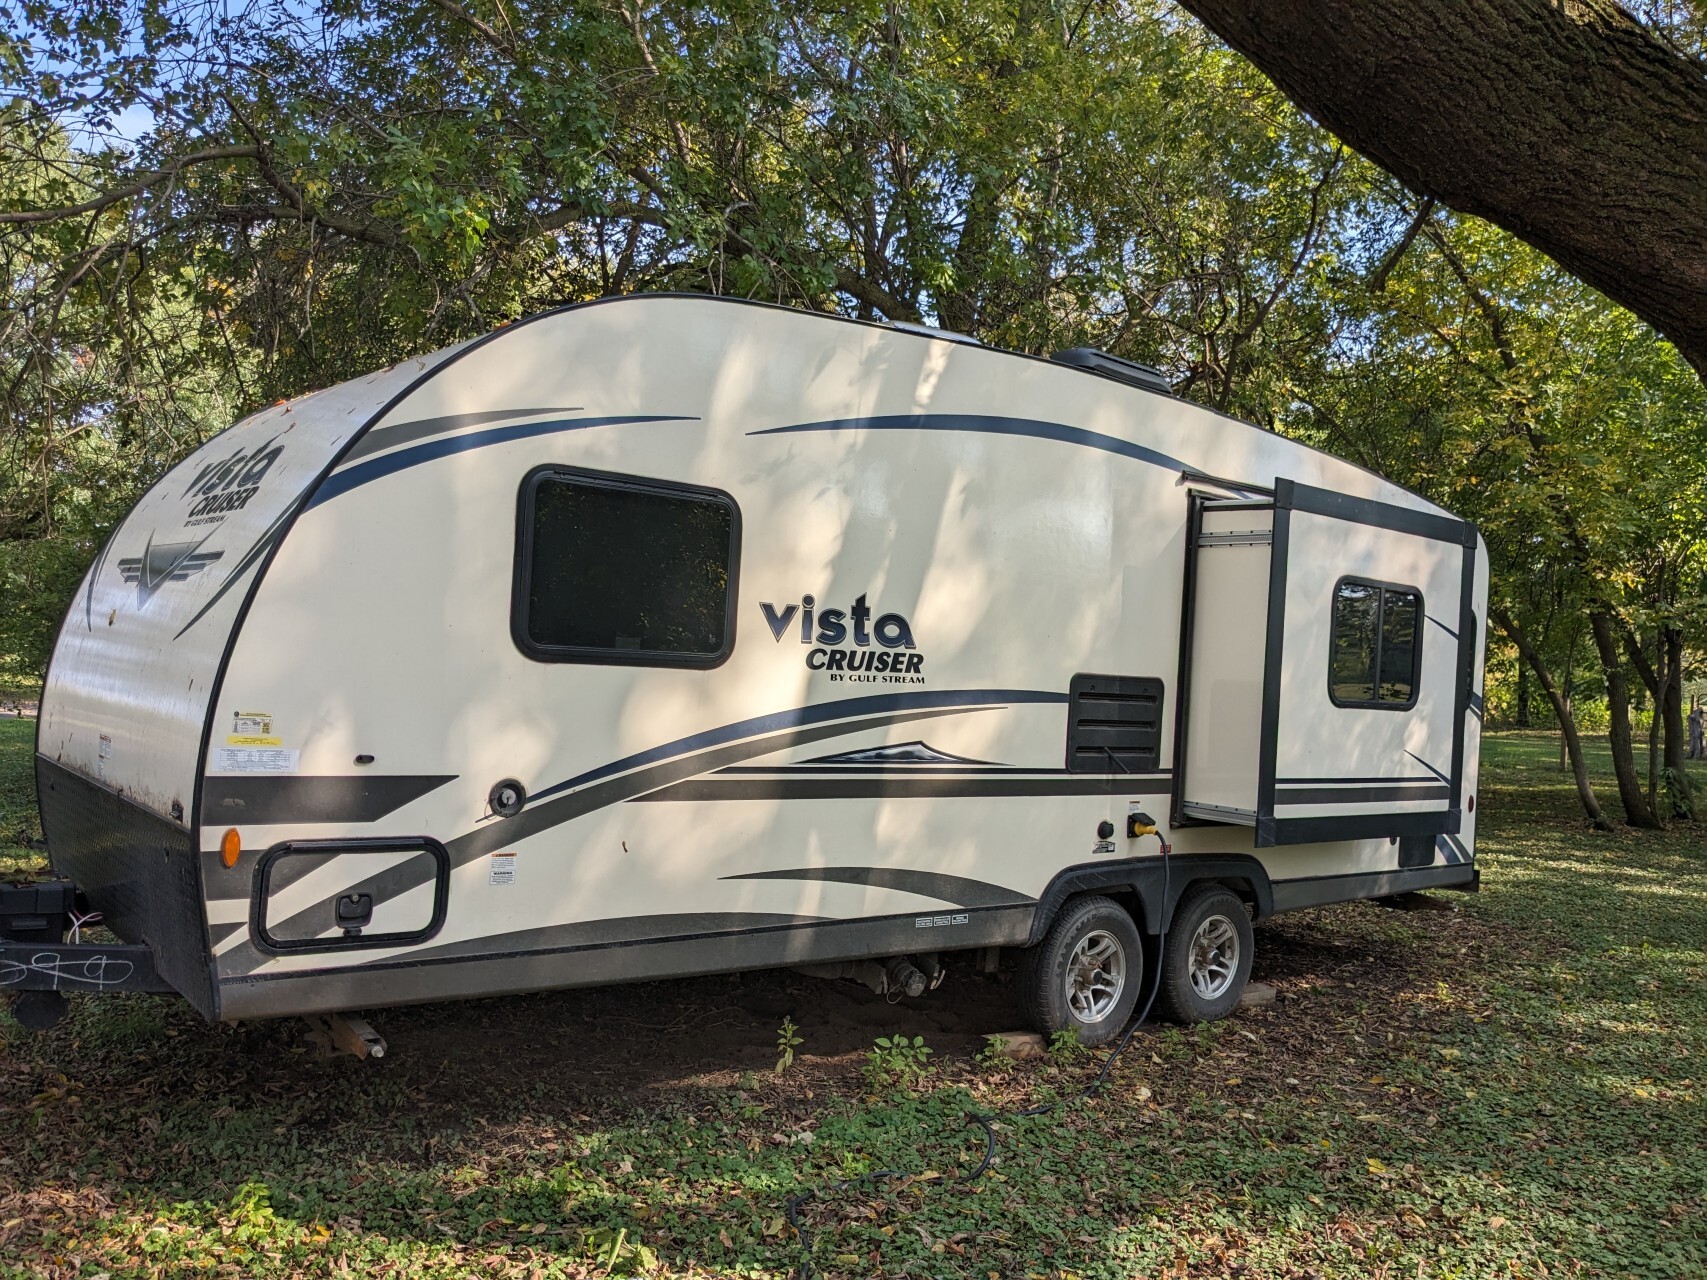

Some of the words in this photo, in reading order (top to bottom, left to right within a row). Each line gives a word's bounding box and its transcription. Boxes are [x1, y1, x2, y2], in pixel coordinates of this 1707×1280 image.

[188, 486, 260, 518] CRUISER
[805, 648, 924, 674] CRUISER
[830, 673, 845, 682] BY
[849, 674, 879, 683] GULF
[881, 675, 925, 685] STREAM
